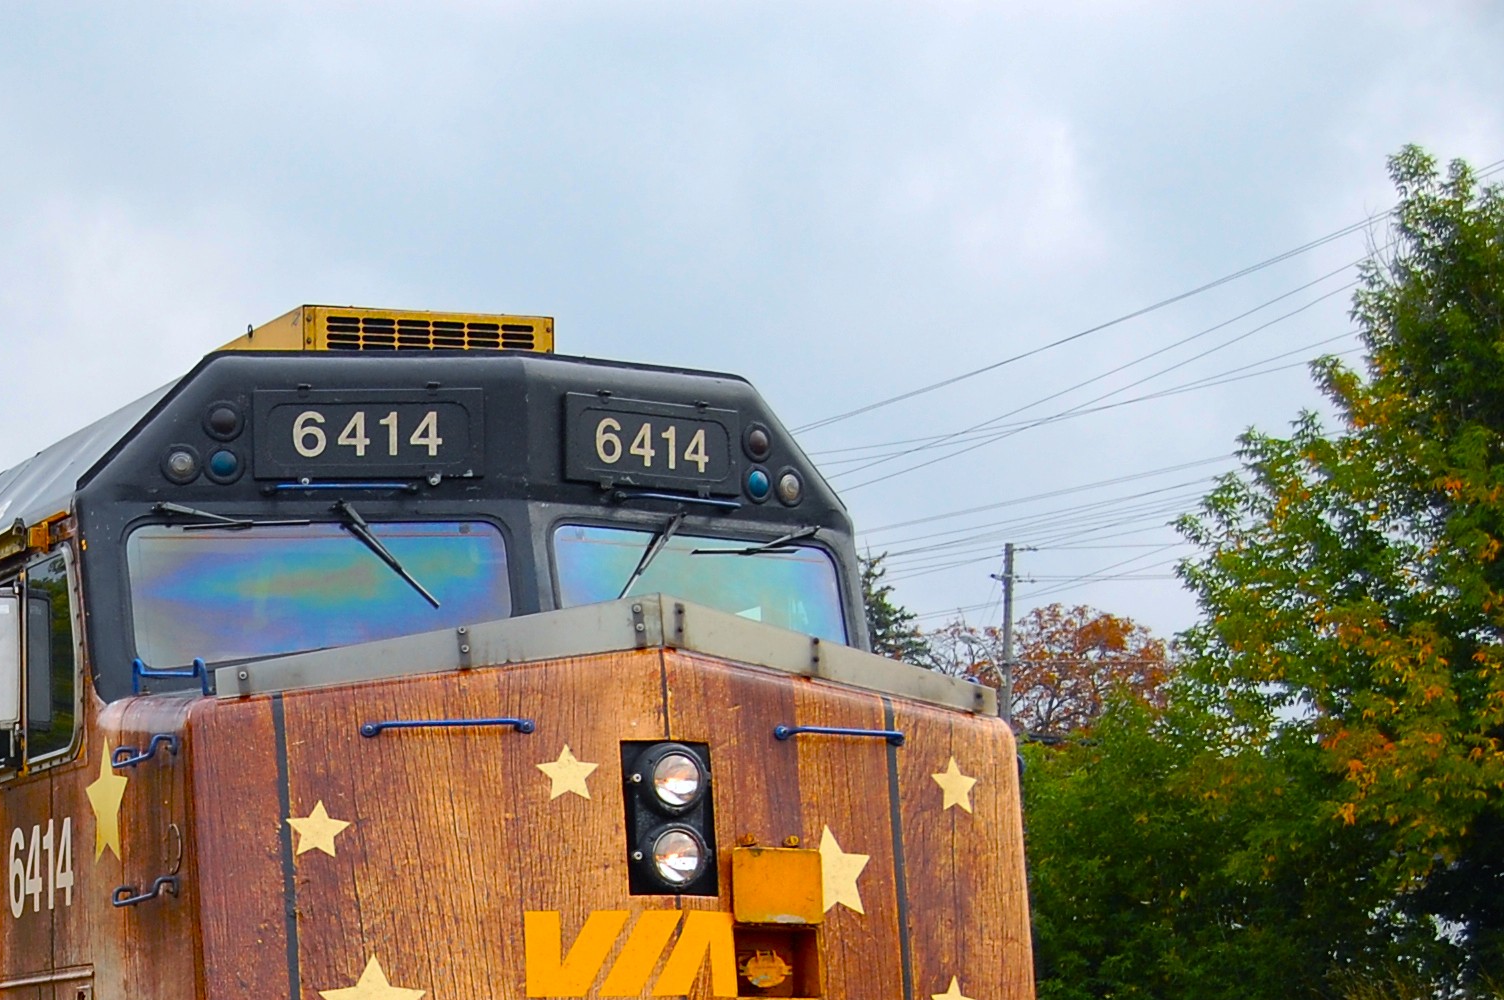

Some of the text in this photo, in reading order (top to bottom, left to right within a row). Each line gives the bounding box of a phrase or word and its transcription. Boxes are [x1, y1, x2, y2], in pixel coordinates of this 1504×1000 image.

[292, 411, 443, 458] 6414
[595, 418, 709, 473] 6414
[9, 816, 74, 918] 6414
[524, 910, 738, 998] VIA
